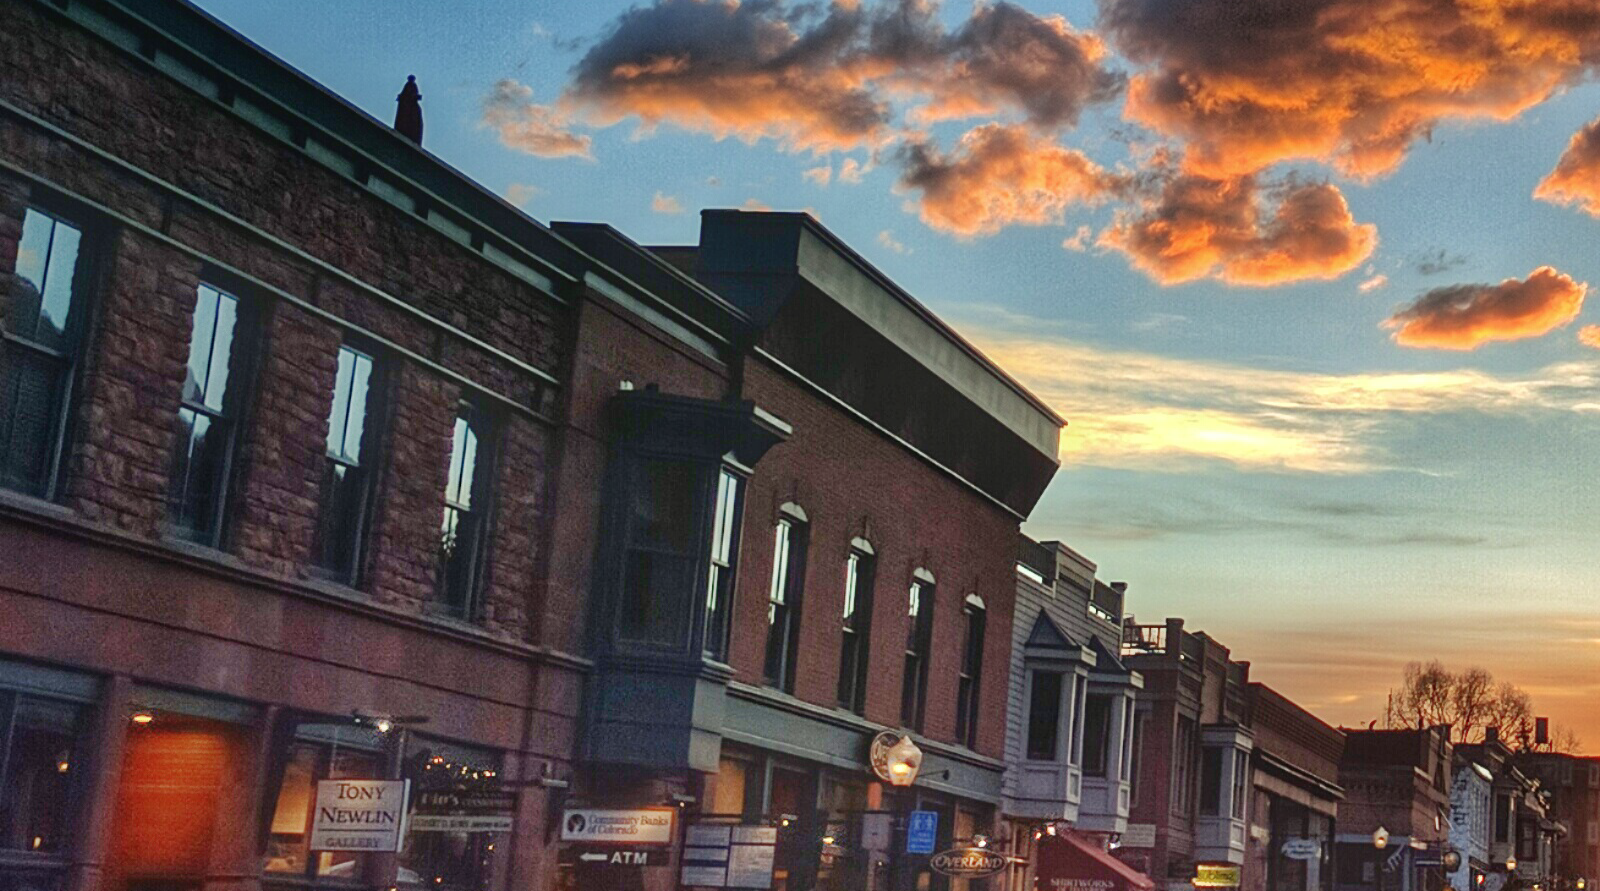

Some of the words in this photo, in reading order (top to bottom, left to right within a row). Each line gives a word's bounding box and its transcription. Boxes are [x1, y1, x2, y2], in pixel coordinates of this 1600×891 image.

[588, 814, 640, 827] Community
[641, 815, 669, 826] Banks
[587, 824, 597, 835] of
[598, 824, 640, 835] Colorado
[325, 837, 380, 849] GALLERY
[610, 851, 649, 865] ATM
[935, 855, 1004, 869] OVERLAND
[1050, 878, 1115, 889] SHIRTWORKS
